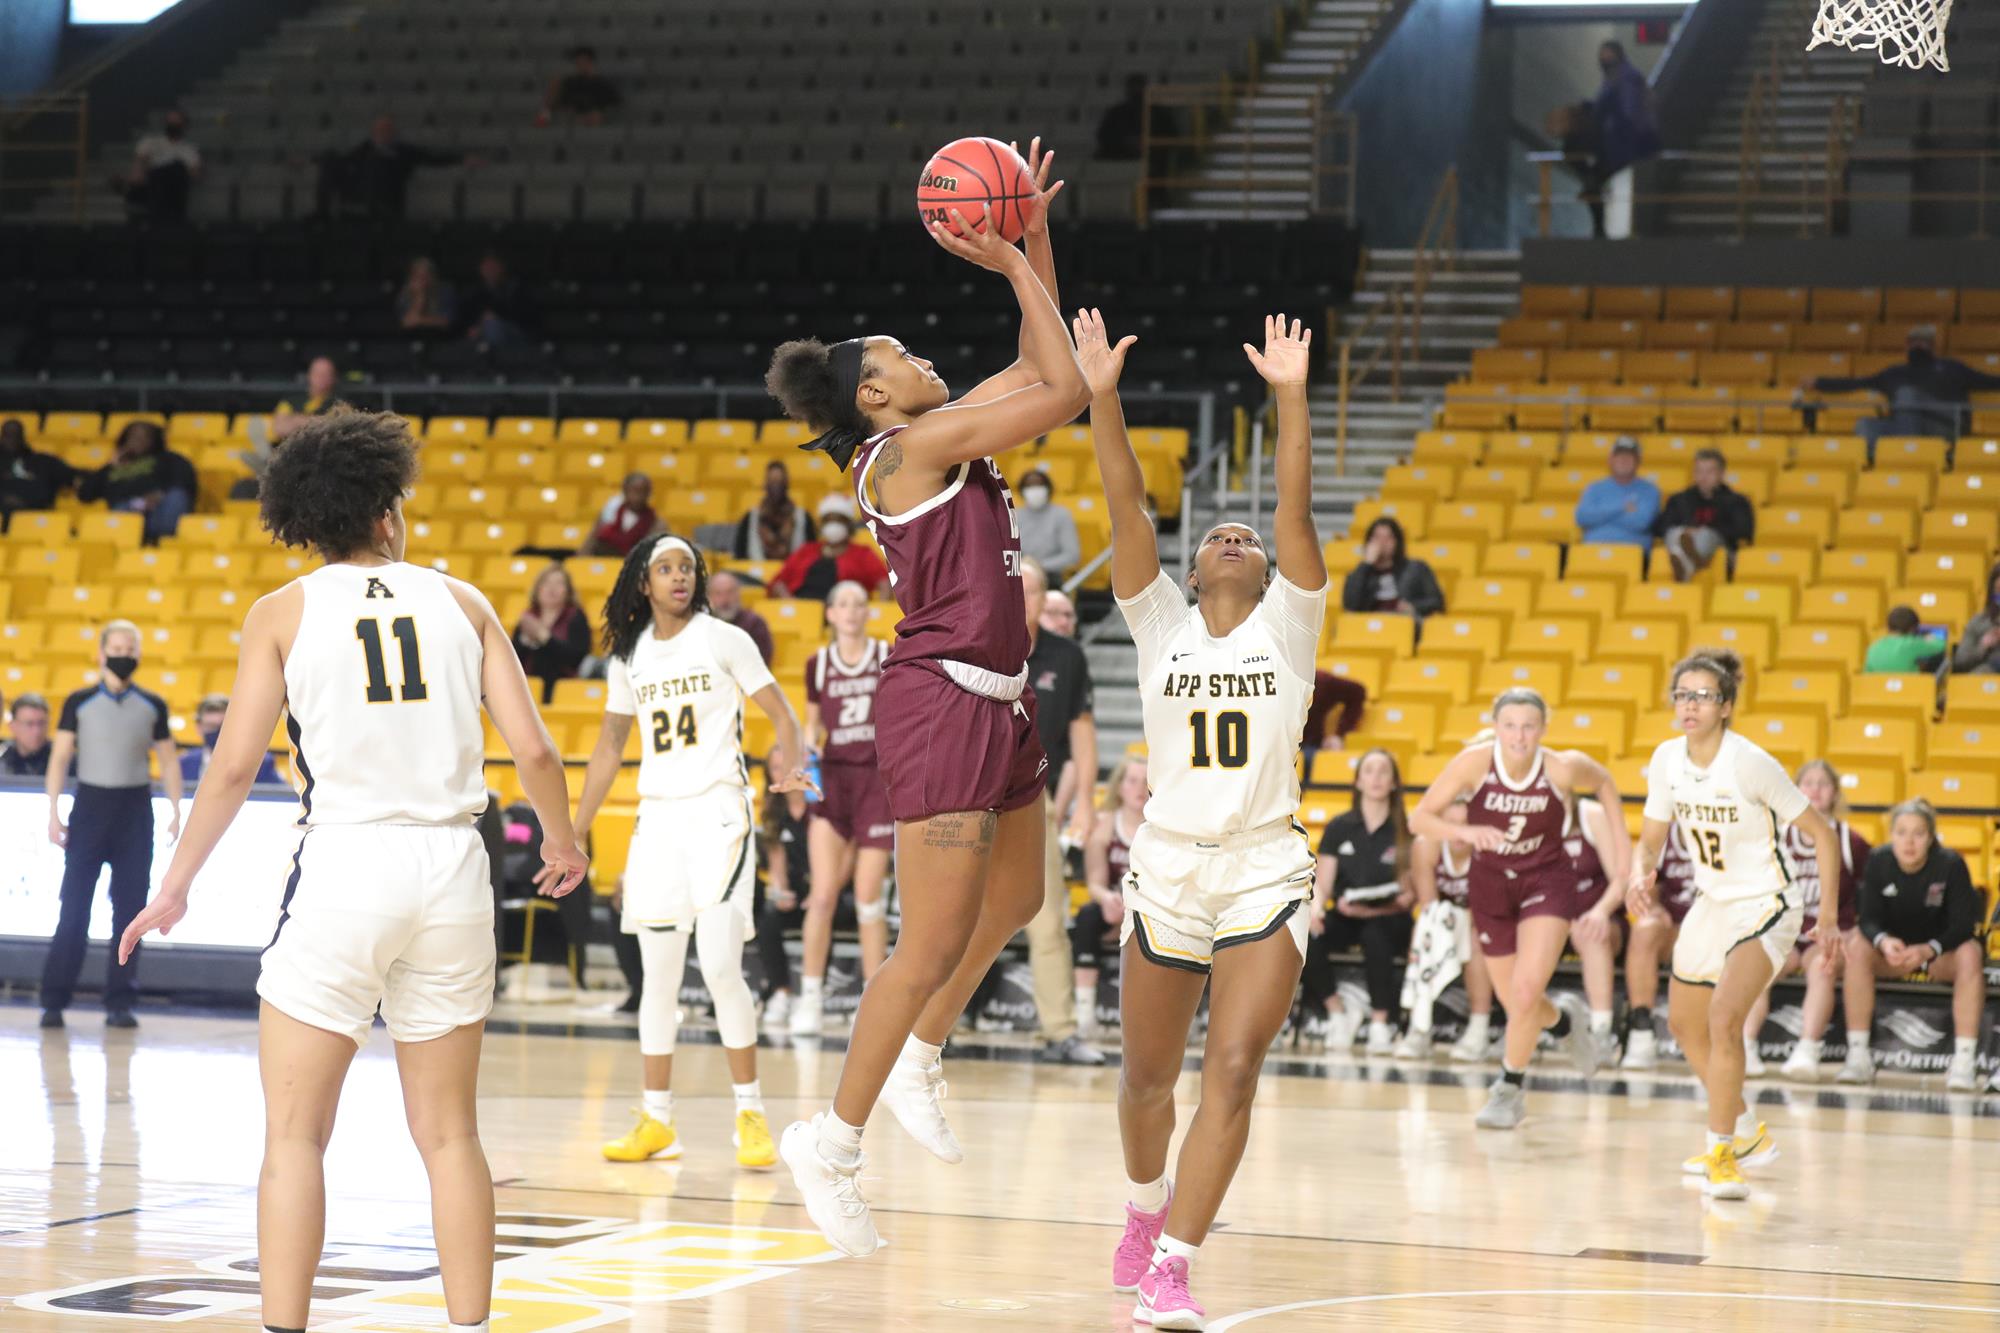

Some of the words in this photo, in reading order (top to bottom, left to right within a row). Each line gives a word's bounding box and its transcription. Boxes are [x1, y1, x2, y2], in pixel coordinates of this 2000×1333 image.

[354, 615, 429, 703] 11
[662, 673, 712, 698] STATE
[1163, 672, 1201, 698] APP
[1209, 671, 1278, 698] STATE
[651, 704, 698, 755] 24
[1188, 710, 1250, 769] 10
[1484, 791, 1549, 813] EASTERN
[1696, 804, 1738, 823] STATE
[1505, 815, 1527, 842] 3
[1690, 827, 1725, 871] 12
